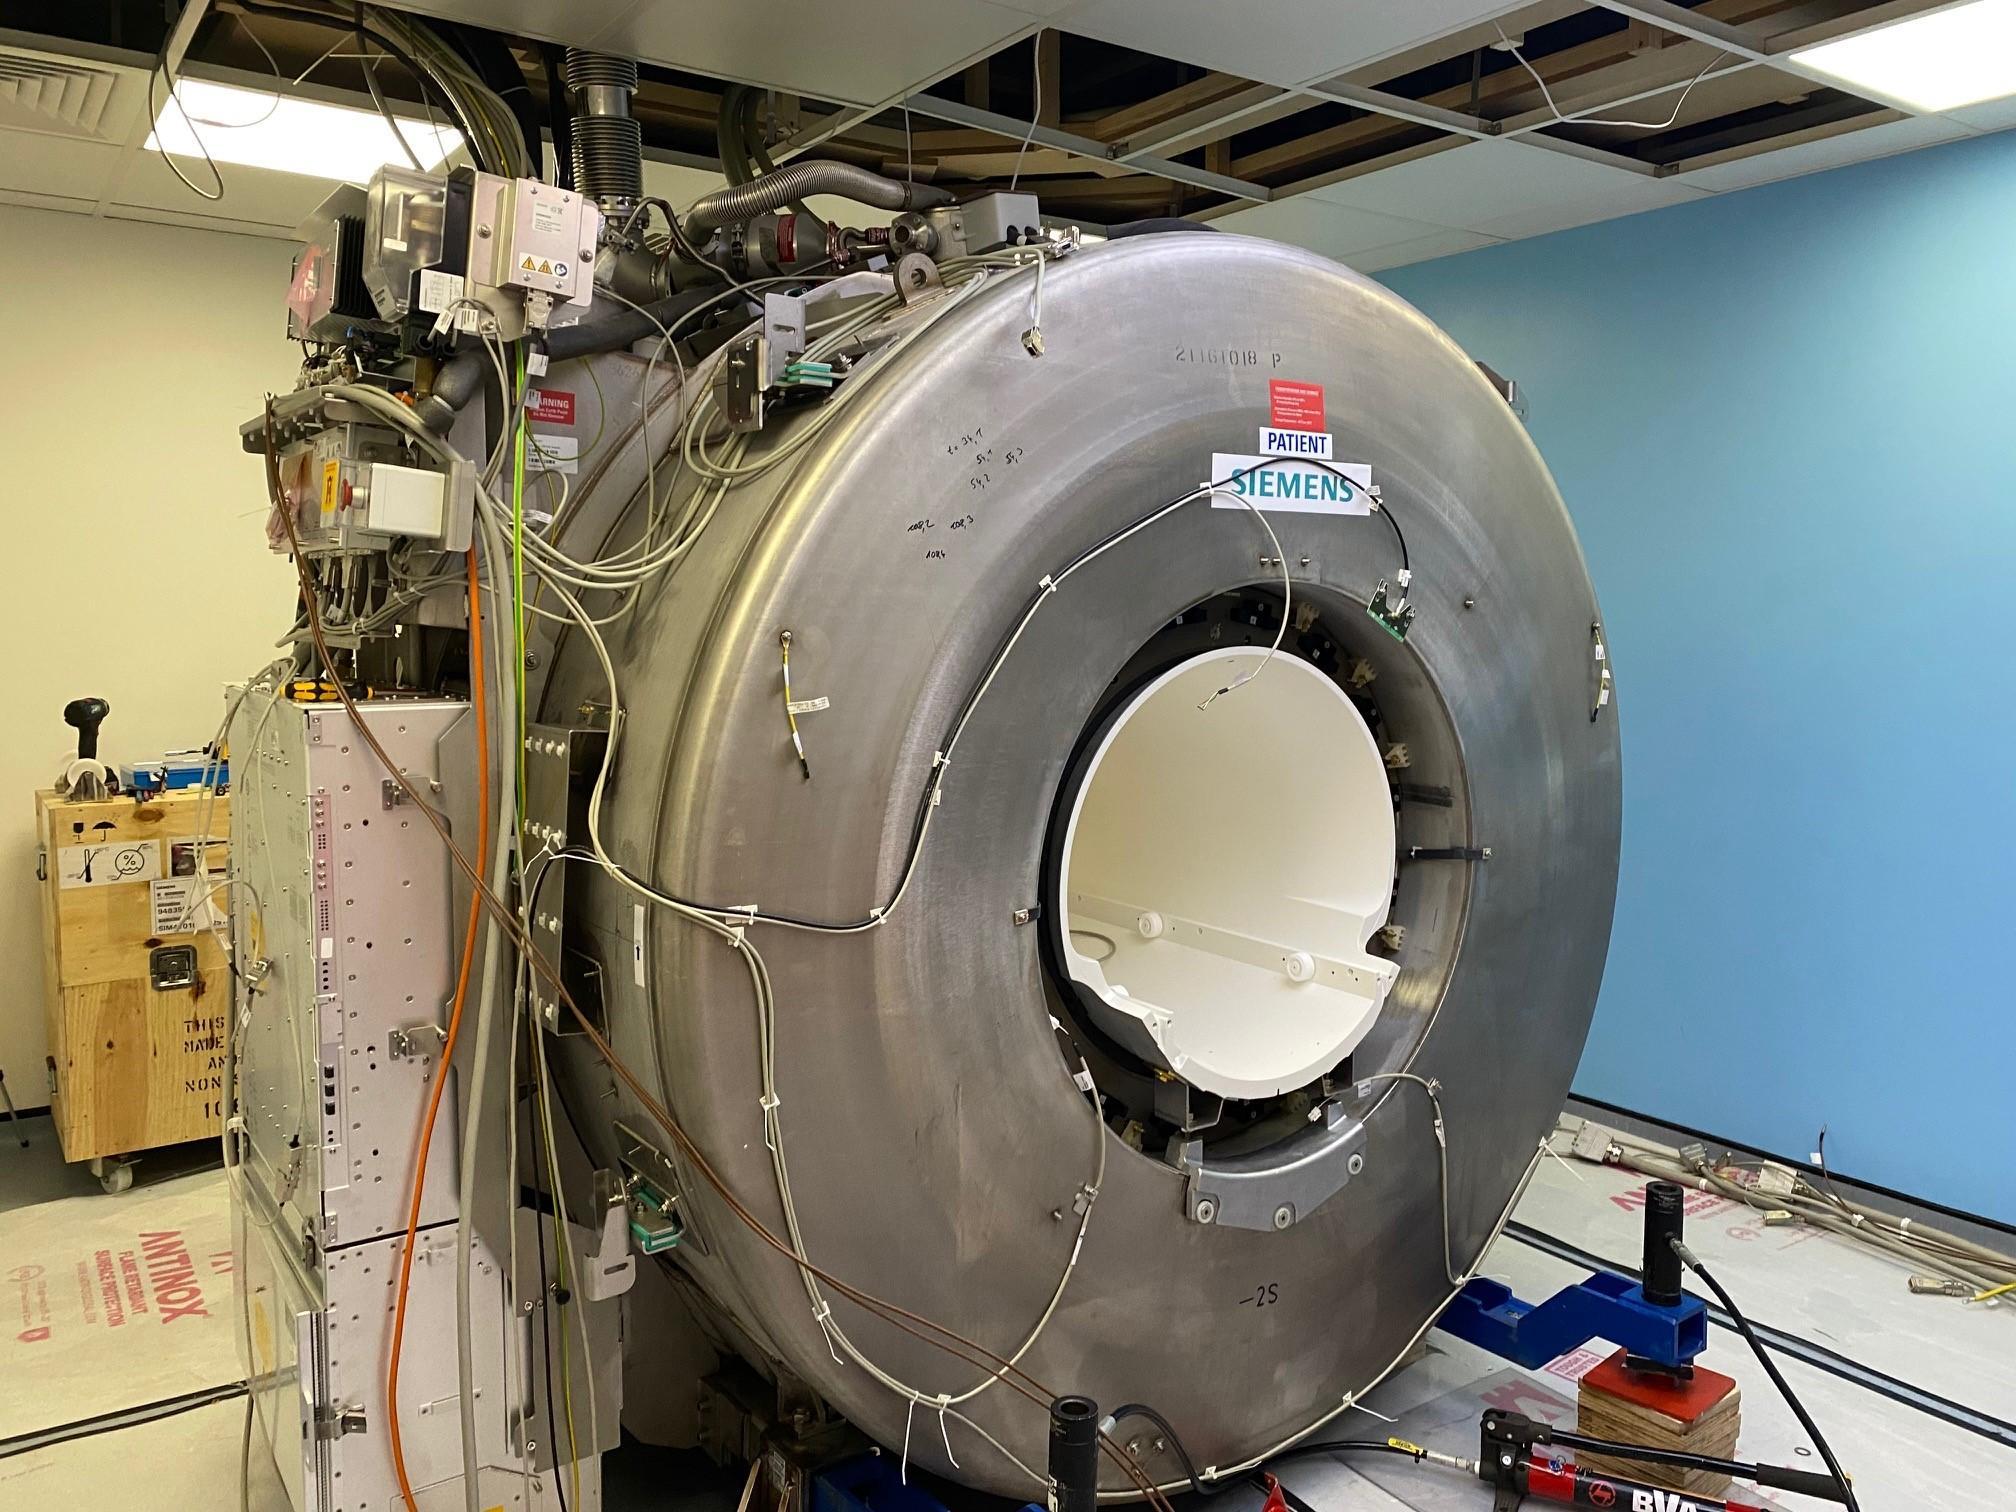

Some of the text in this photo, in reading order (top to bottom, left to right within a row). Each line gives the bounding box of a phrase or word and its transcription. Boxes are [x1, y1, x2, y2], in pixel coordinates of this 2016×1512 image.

[1268, 432, 1327, 454] PATIENT
[1231, 468, 1354, 503] SIEMENS
[184, 1016, 225, 1034] THIS
[184, 1035, 225, 1054] MADE
[95, 1250, 126, 1327] SURFACE PROTECTION
[138, 1230, 208, 1325] ANTINOX
